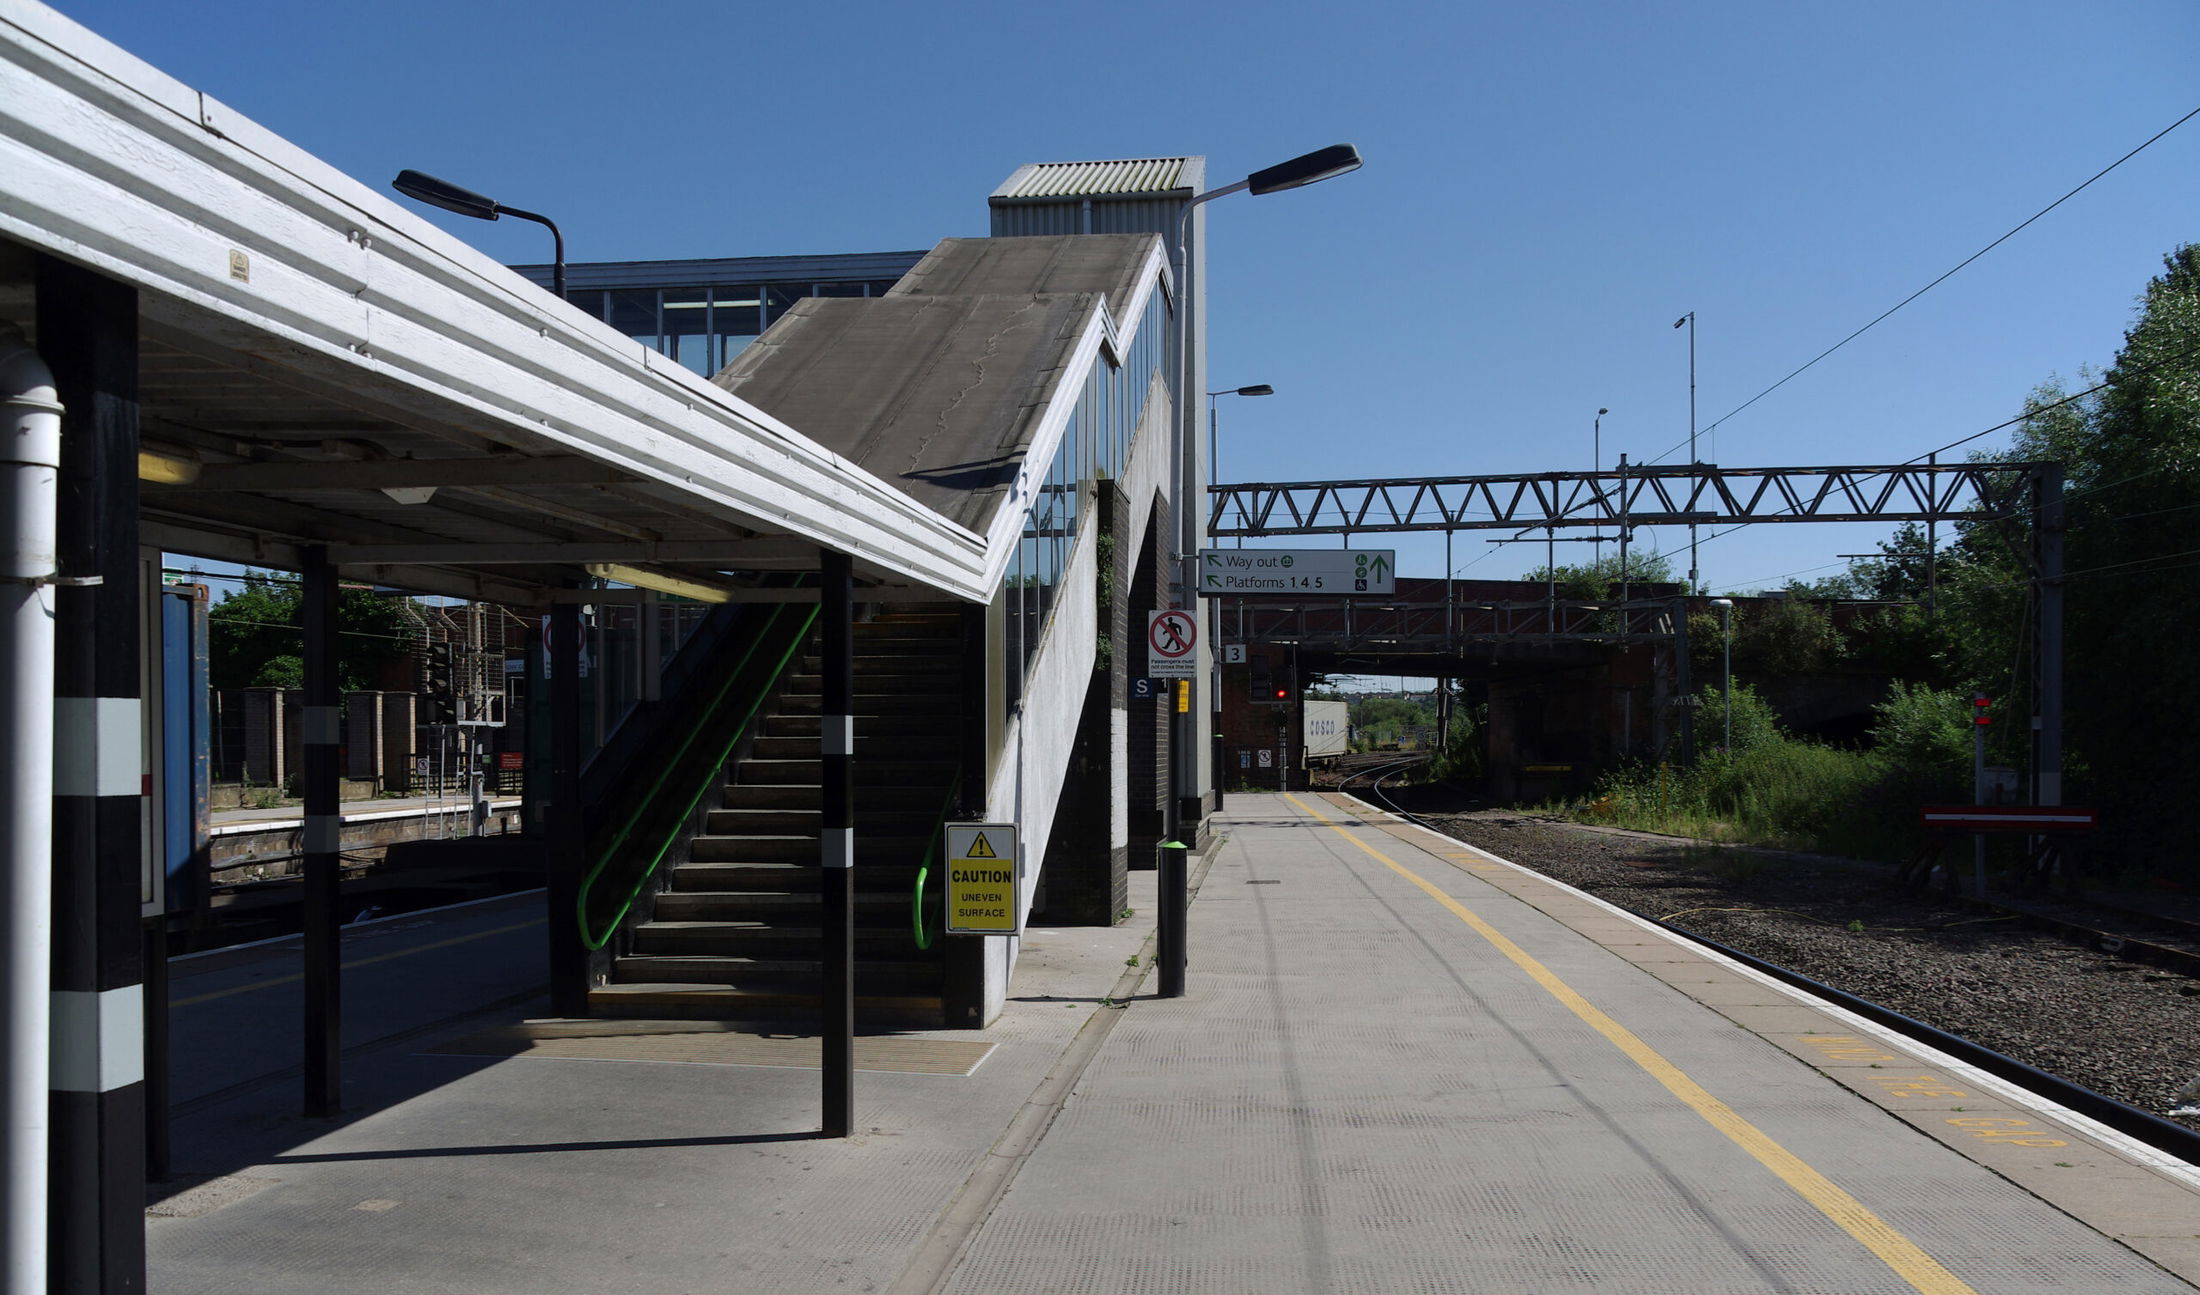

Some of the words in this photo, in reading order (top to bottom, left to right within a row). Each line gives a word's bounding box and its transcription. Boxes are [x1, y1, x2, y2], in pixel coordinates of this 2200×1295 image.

[1226, 556, 1253, 570] Way
[1257, 557, 1278, 568] out
[1226, 575, 1285, 589] Platforms
[1315, 576, 1323, 588] 5
[1231, 648, 1240, 661] 3
[1136, 679, 1148, 694] S
[1310, 720, 1335, 736] COSCO
[952, 870, 1011, 883] CAUTION
[961, 893, 1002, 902] UNEVEN
[958, 908, 1005, 917] SURFACE
[1798, 1037, 1895, 1061] MIND
[1866, 1075, 1968, 1098] THE
[1945, 1118, 2069, 1148] GAP
